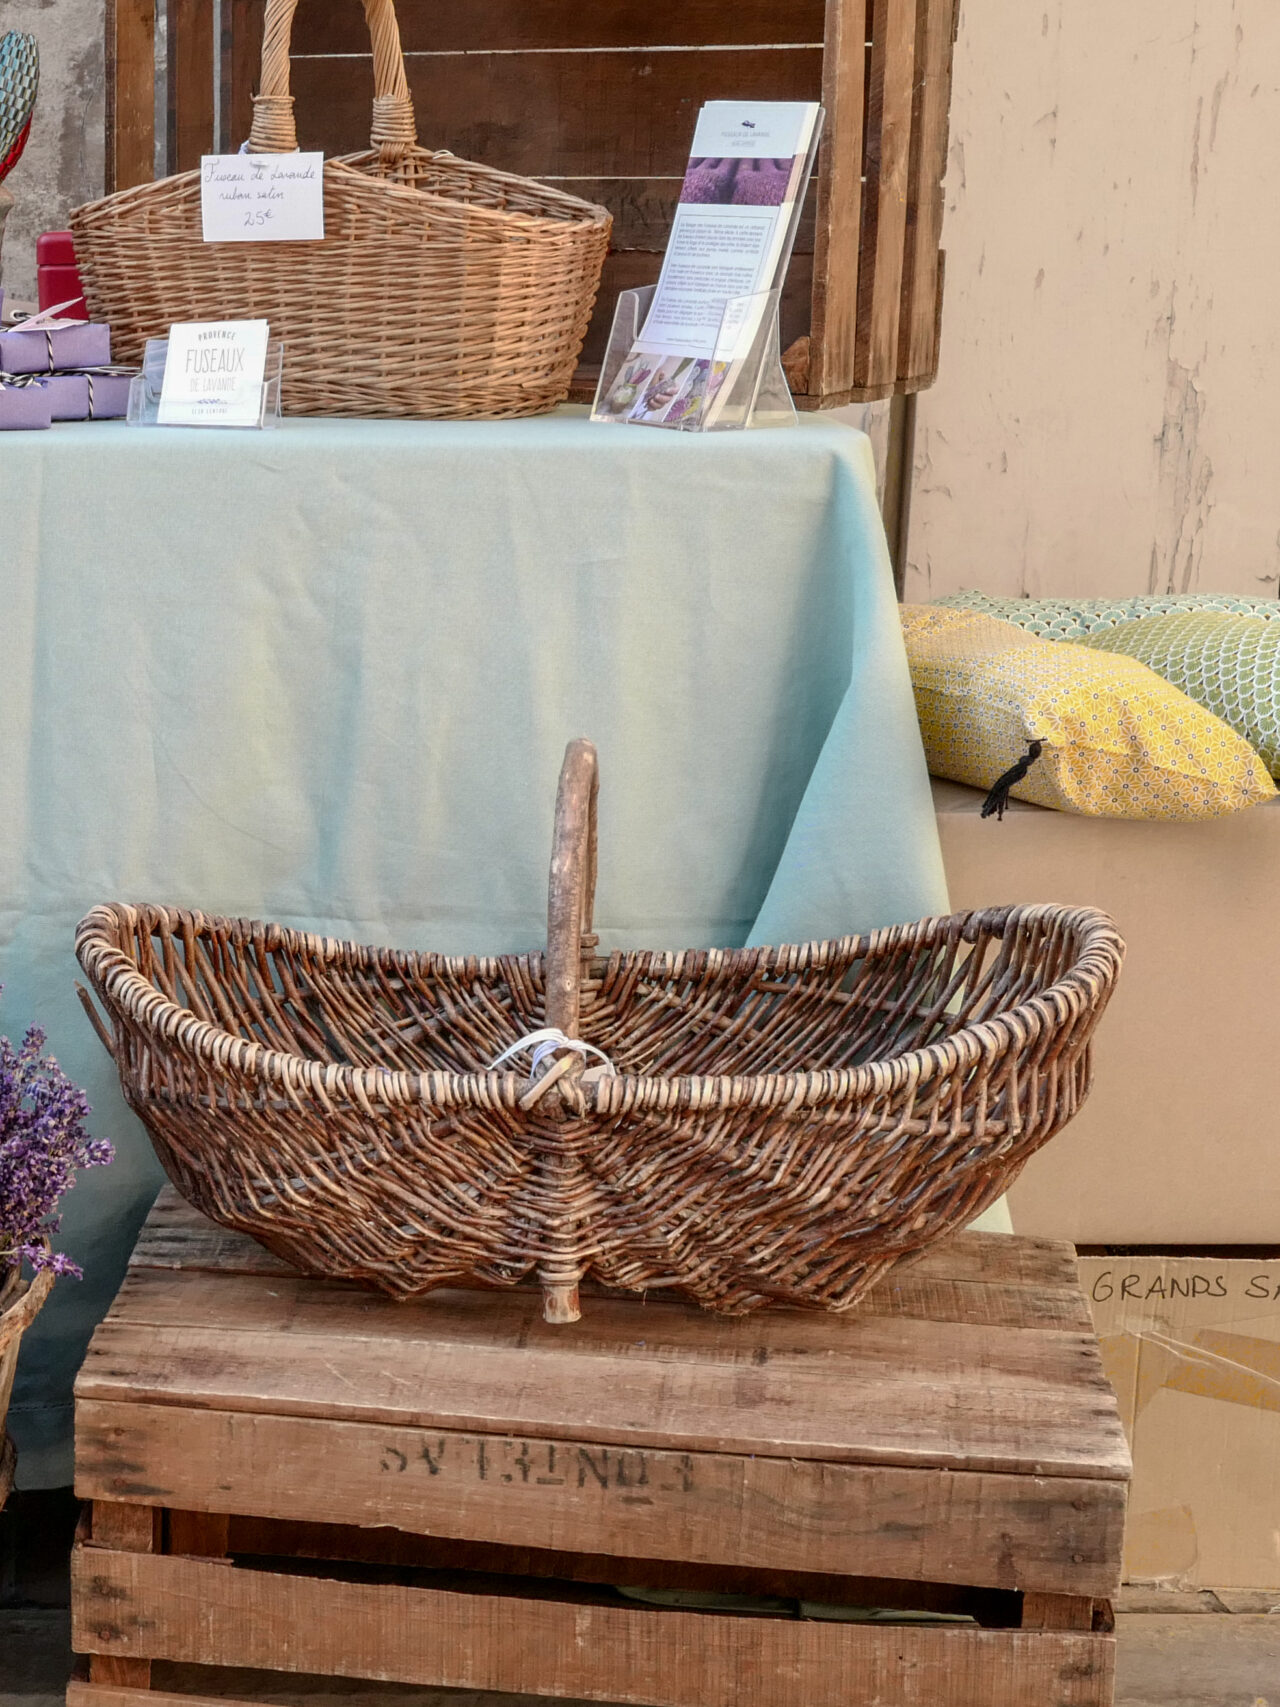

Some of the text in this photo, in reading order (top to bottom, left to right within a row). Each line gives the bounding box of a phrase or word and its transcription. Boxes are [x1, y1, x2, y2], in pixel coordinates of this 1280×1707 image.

[257, 186, 285, 200] satin
[198, 330, 236, 342] PROVENCE
[185, 347, 245, 373] FUSEAUX
[1092, 1271, 1228, 1303] GRANDS
